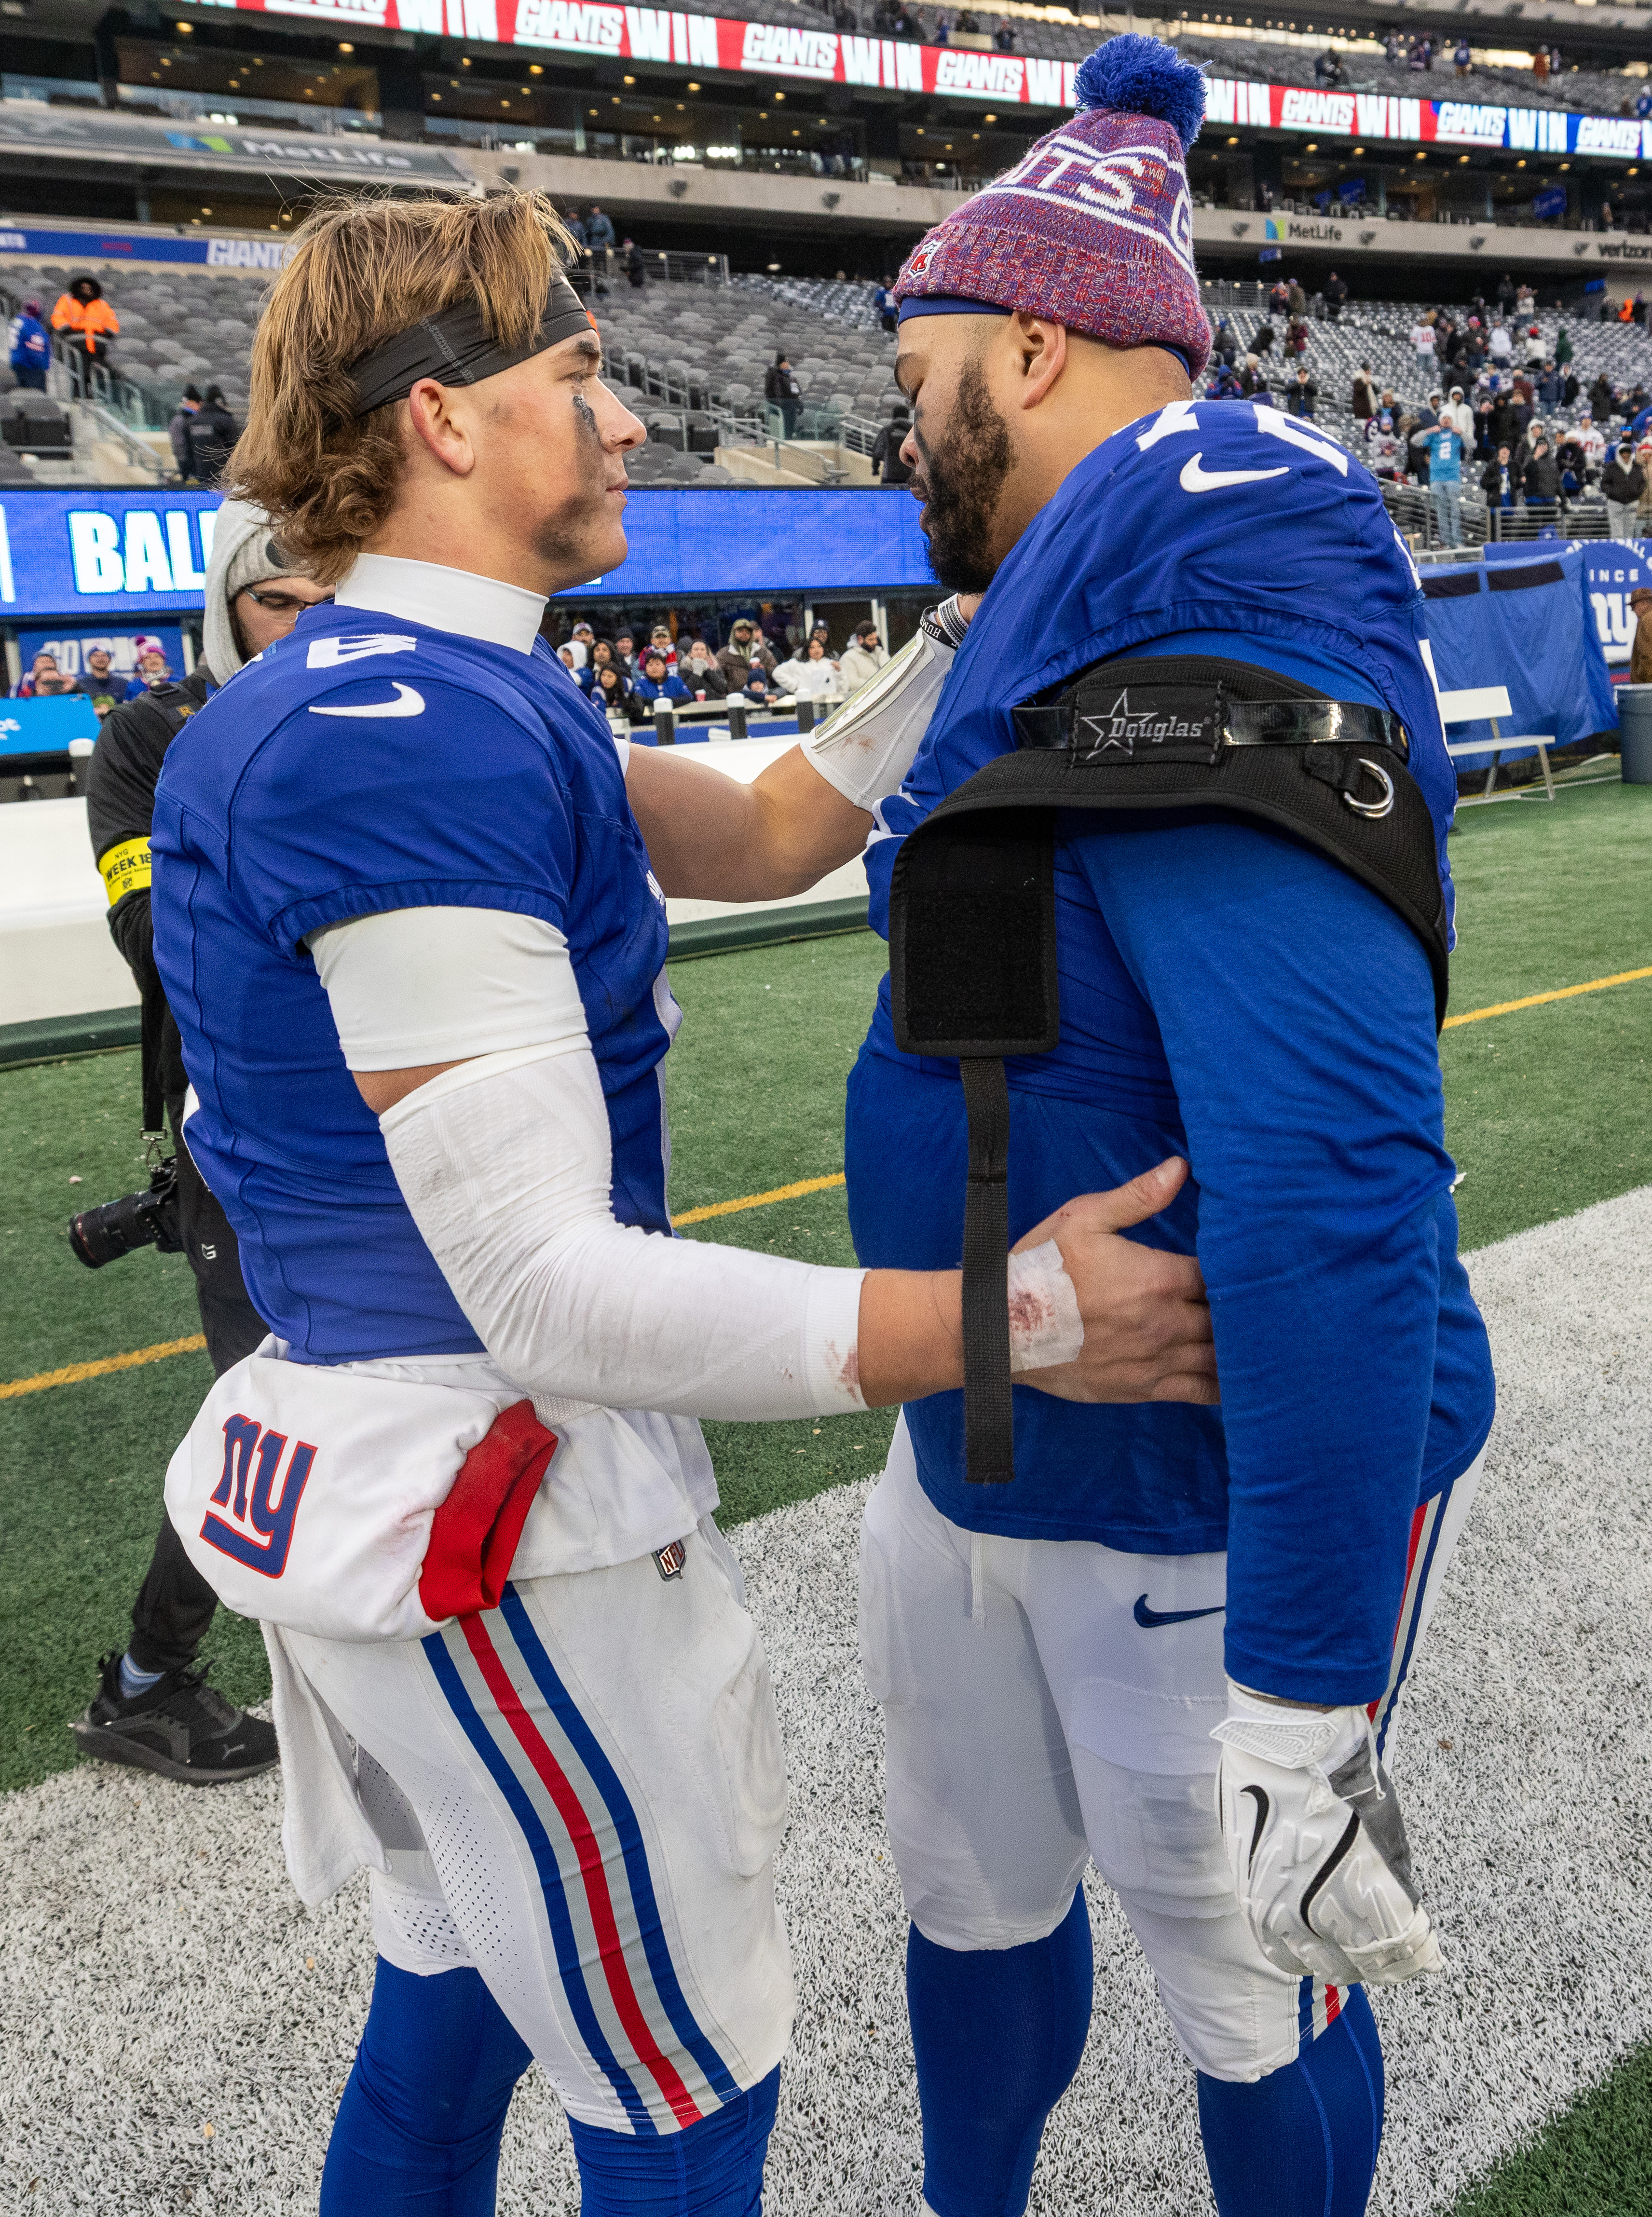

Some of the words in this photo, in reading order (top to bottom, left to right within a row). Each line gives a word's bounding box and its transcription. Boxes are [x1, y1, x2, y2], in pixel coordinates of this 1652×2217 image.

[517, 0, 623, 46] GIANTS
[626, 6, 719, 68] WIN
[743, 23, 837, 69] GIANTS
[841, 34, 922, 93] WIN
[936, 50, 1024, 93] GIANTS
[1205, 77, 1271, 127] WIN
[1282, 89, 1354, 126] GIANTS
[1356, 94, 1420, 141] WIN
[1437, 102, 1505, 136] GIANTS
[1508, 108, 1567, 153] WIN
[1576, 117, 1642, 149] GIANTS
[1288, 222, 1342, 240] MetLife
[1589, 568, 1639, 583] INCE
[1108, 716, 1203, 742] Douglas
[115, 848, 128, 859] NYG
[106, 856, 137, 882] WEEK
[138, 853, 151, 865] 18
[661, 1542, 683, 1573] NFL
